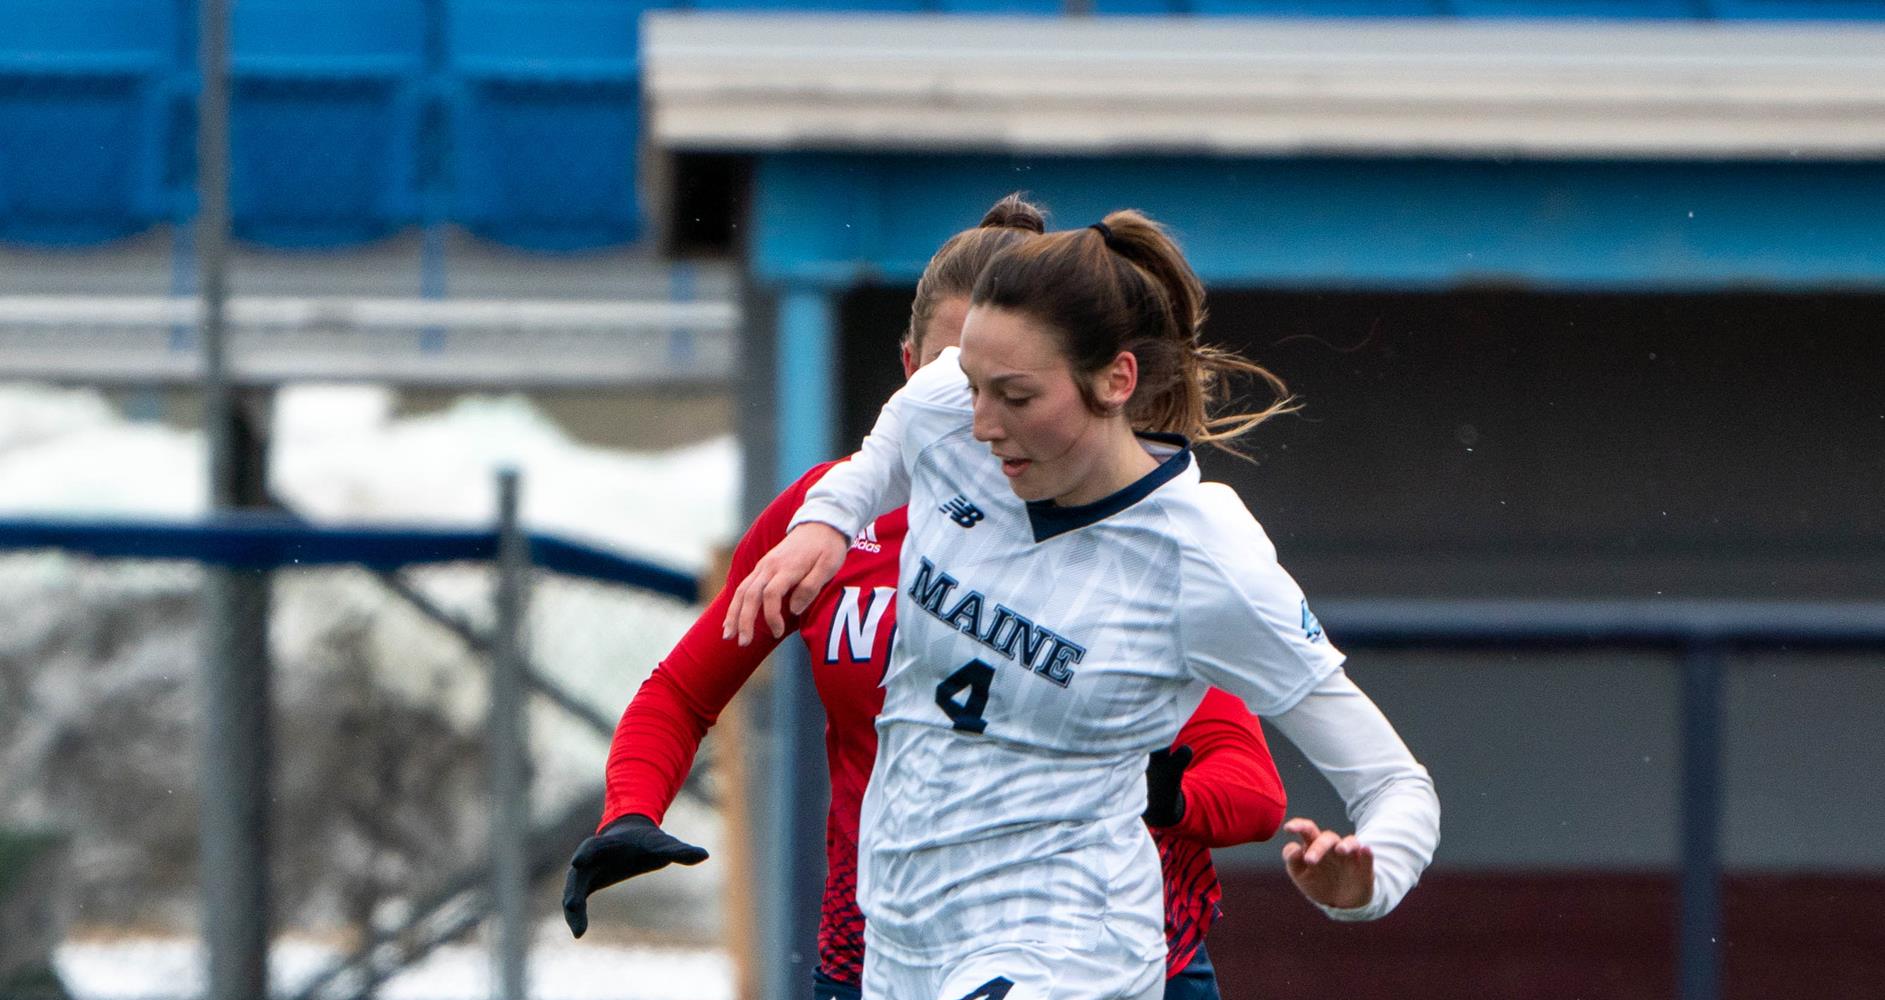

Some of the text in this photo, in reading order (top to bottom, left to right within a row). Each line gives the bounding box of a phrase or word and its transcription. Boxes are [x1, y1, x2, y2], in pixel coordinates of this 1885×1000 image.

[824, 586, 899, 688] N
[908, 555, 1087, 688] MAINE
[935, 658, 995, 733] 4
